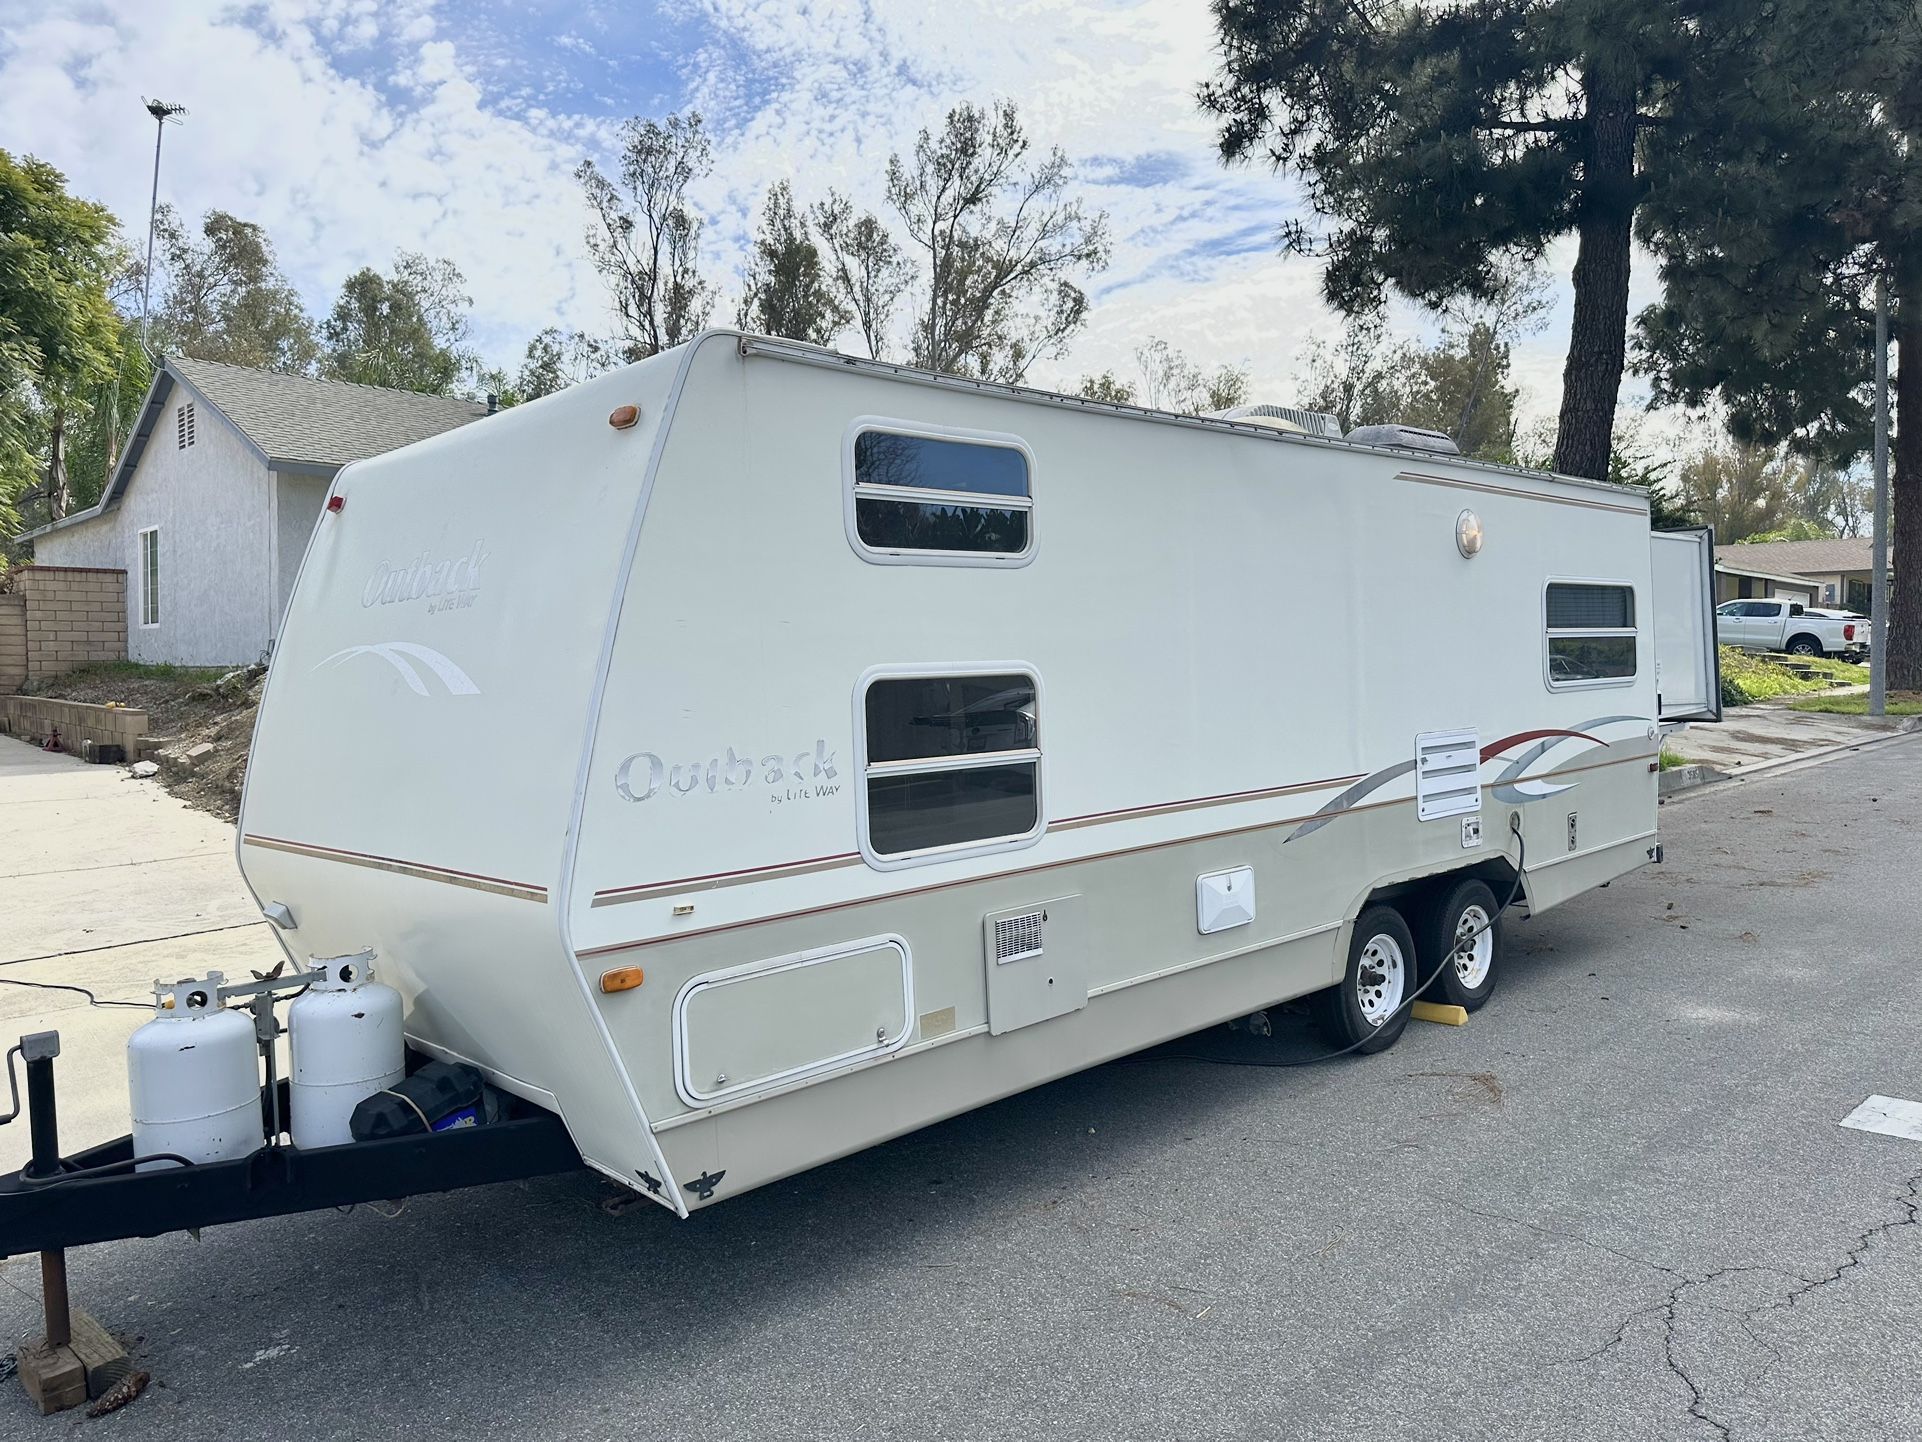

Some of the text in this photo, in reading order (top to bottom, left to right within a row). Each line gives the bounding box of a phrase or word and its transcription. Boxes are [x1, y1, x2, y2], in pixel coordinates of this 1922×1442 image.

[361, 538, 492, 609] Outback
[614, 738, 838, 803] Outback
[771, 794, 783, 805] by
[815, 784, 841, 798] WAY
